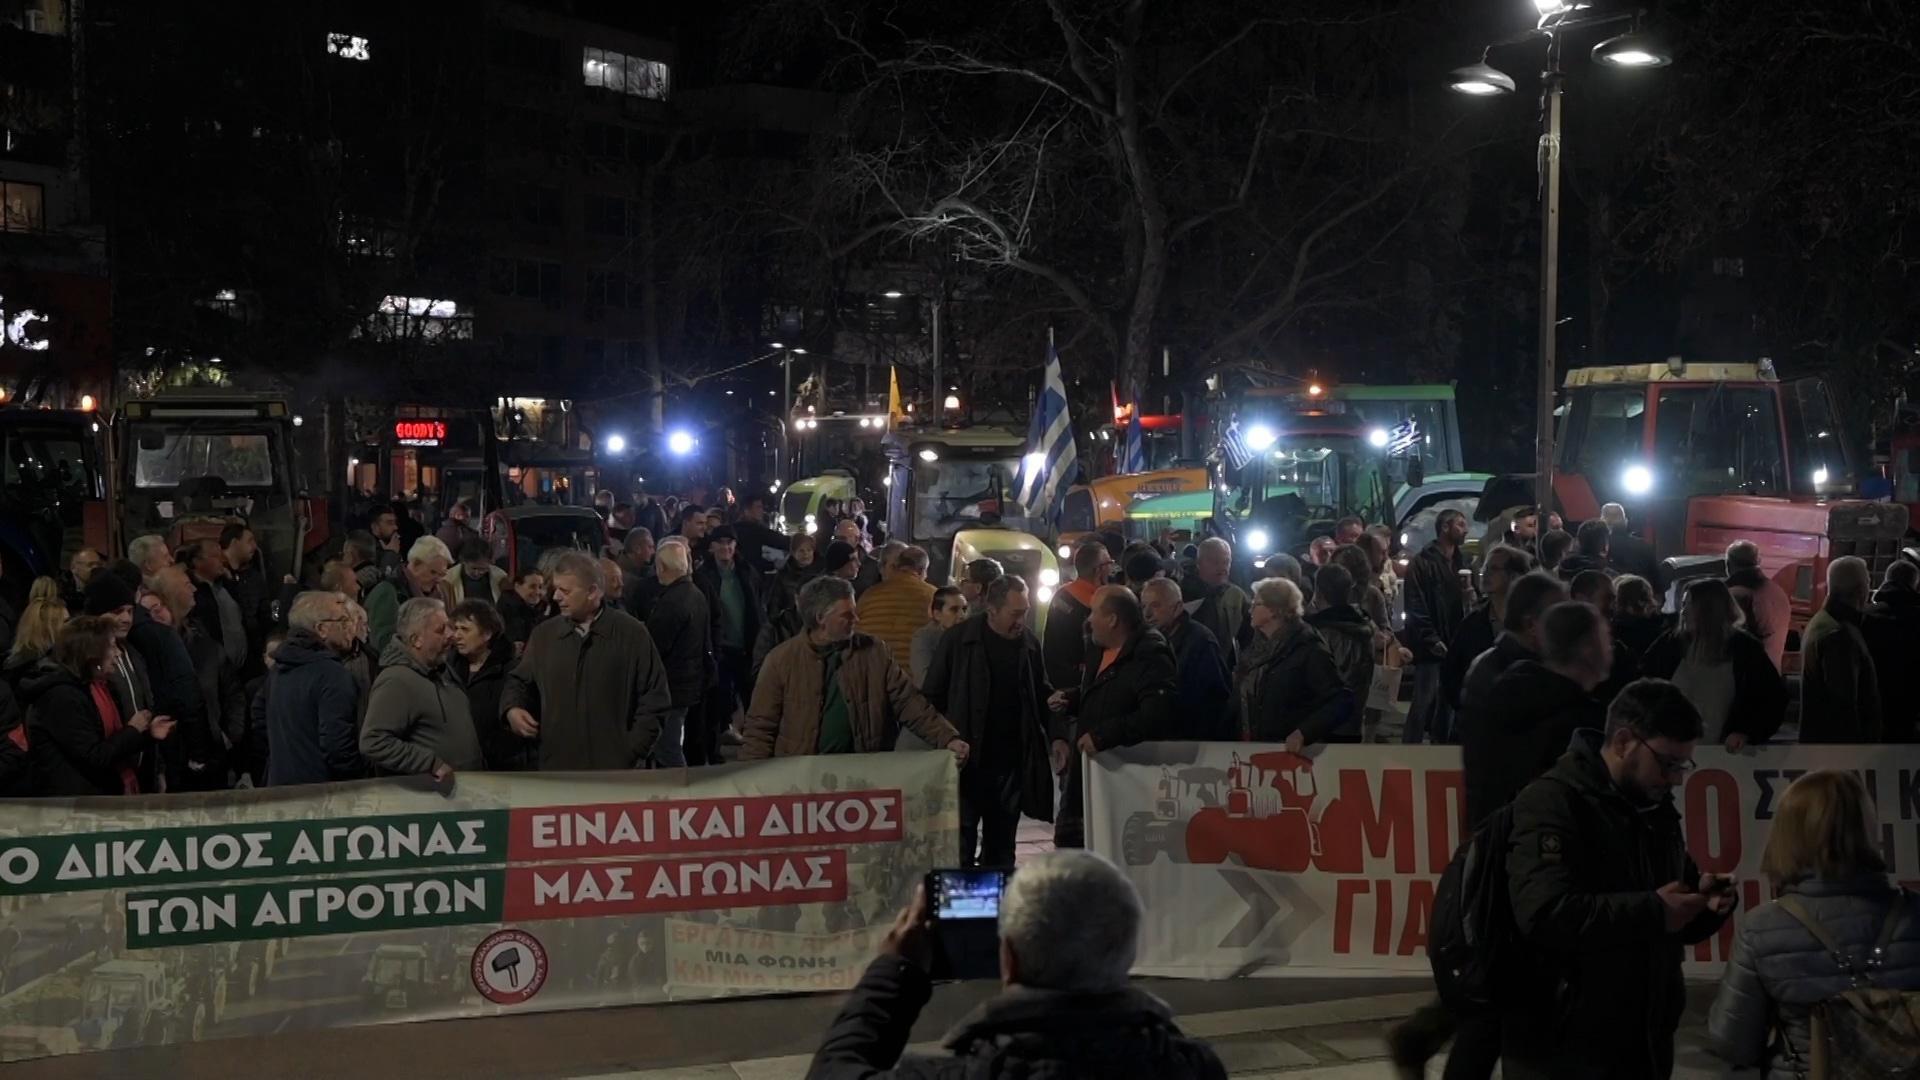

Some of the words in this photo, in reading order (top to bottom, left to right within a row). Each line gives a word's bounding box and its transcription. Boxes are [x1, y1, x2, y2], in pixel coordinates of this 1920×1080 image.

[396, 421, 445, 438] GOODY'S
[532, 809, 655, 848] ΕΙΝΑΙ
[669, 805, 745, 840] ΚΑΙ
[759, 797, 897, 836] ΔΙΚΟΣ
[0, 847, 40, 884] Ο
[55, 832, 274, 880] ΔΙΚΑΙΟΣ
[286, 819, 487, 865] ΑΓΩΝΑΣ
[533, 867, 634, 906] ΜΑΣ
[646, 855, 833, 899] ΑΓΩΝΑΣ
[127, 893, 236, 936] ΤΩΝ
[251, 877, 486, 926] ΑΓΡΟΤΩΝ
[705, 949, 749, 966] ΜΙΑ
[757, 955, 837, 969] ΦΩΝΗ
